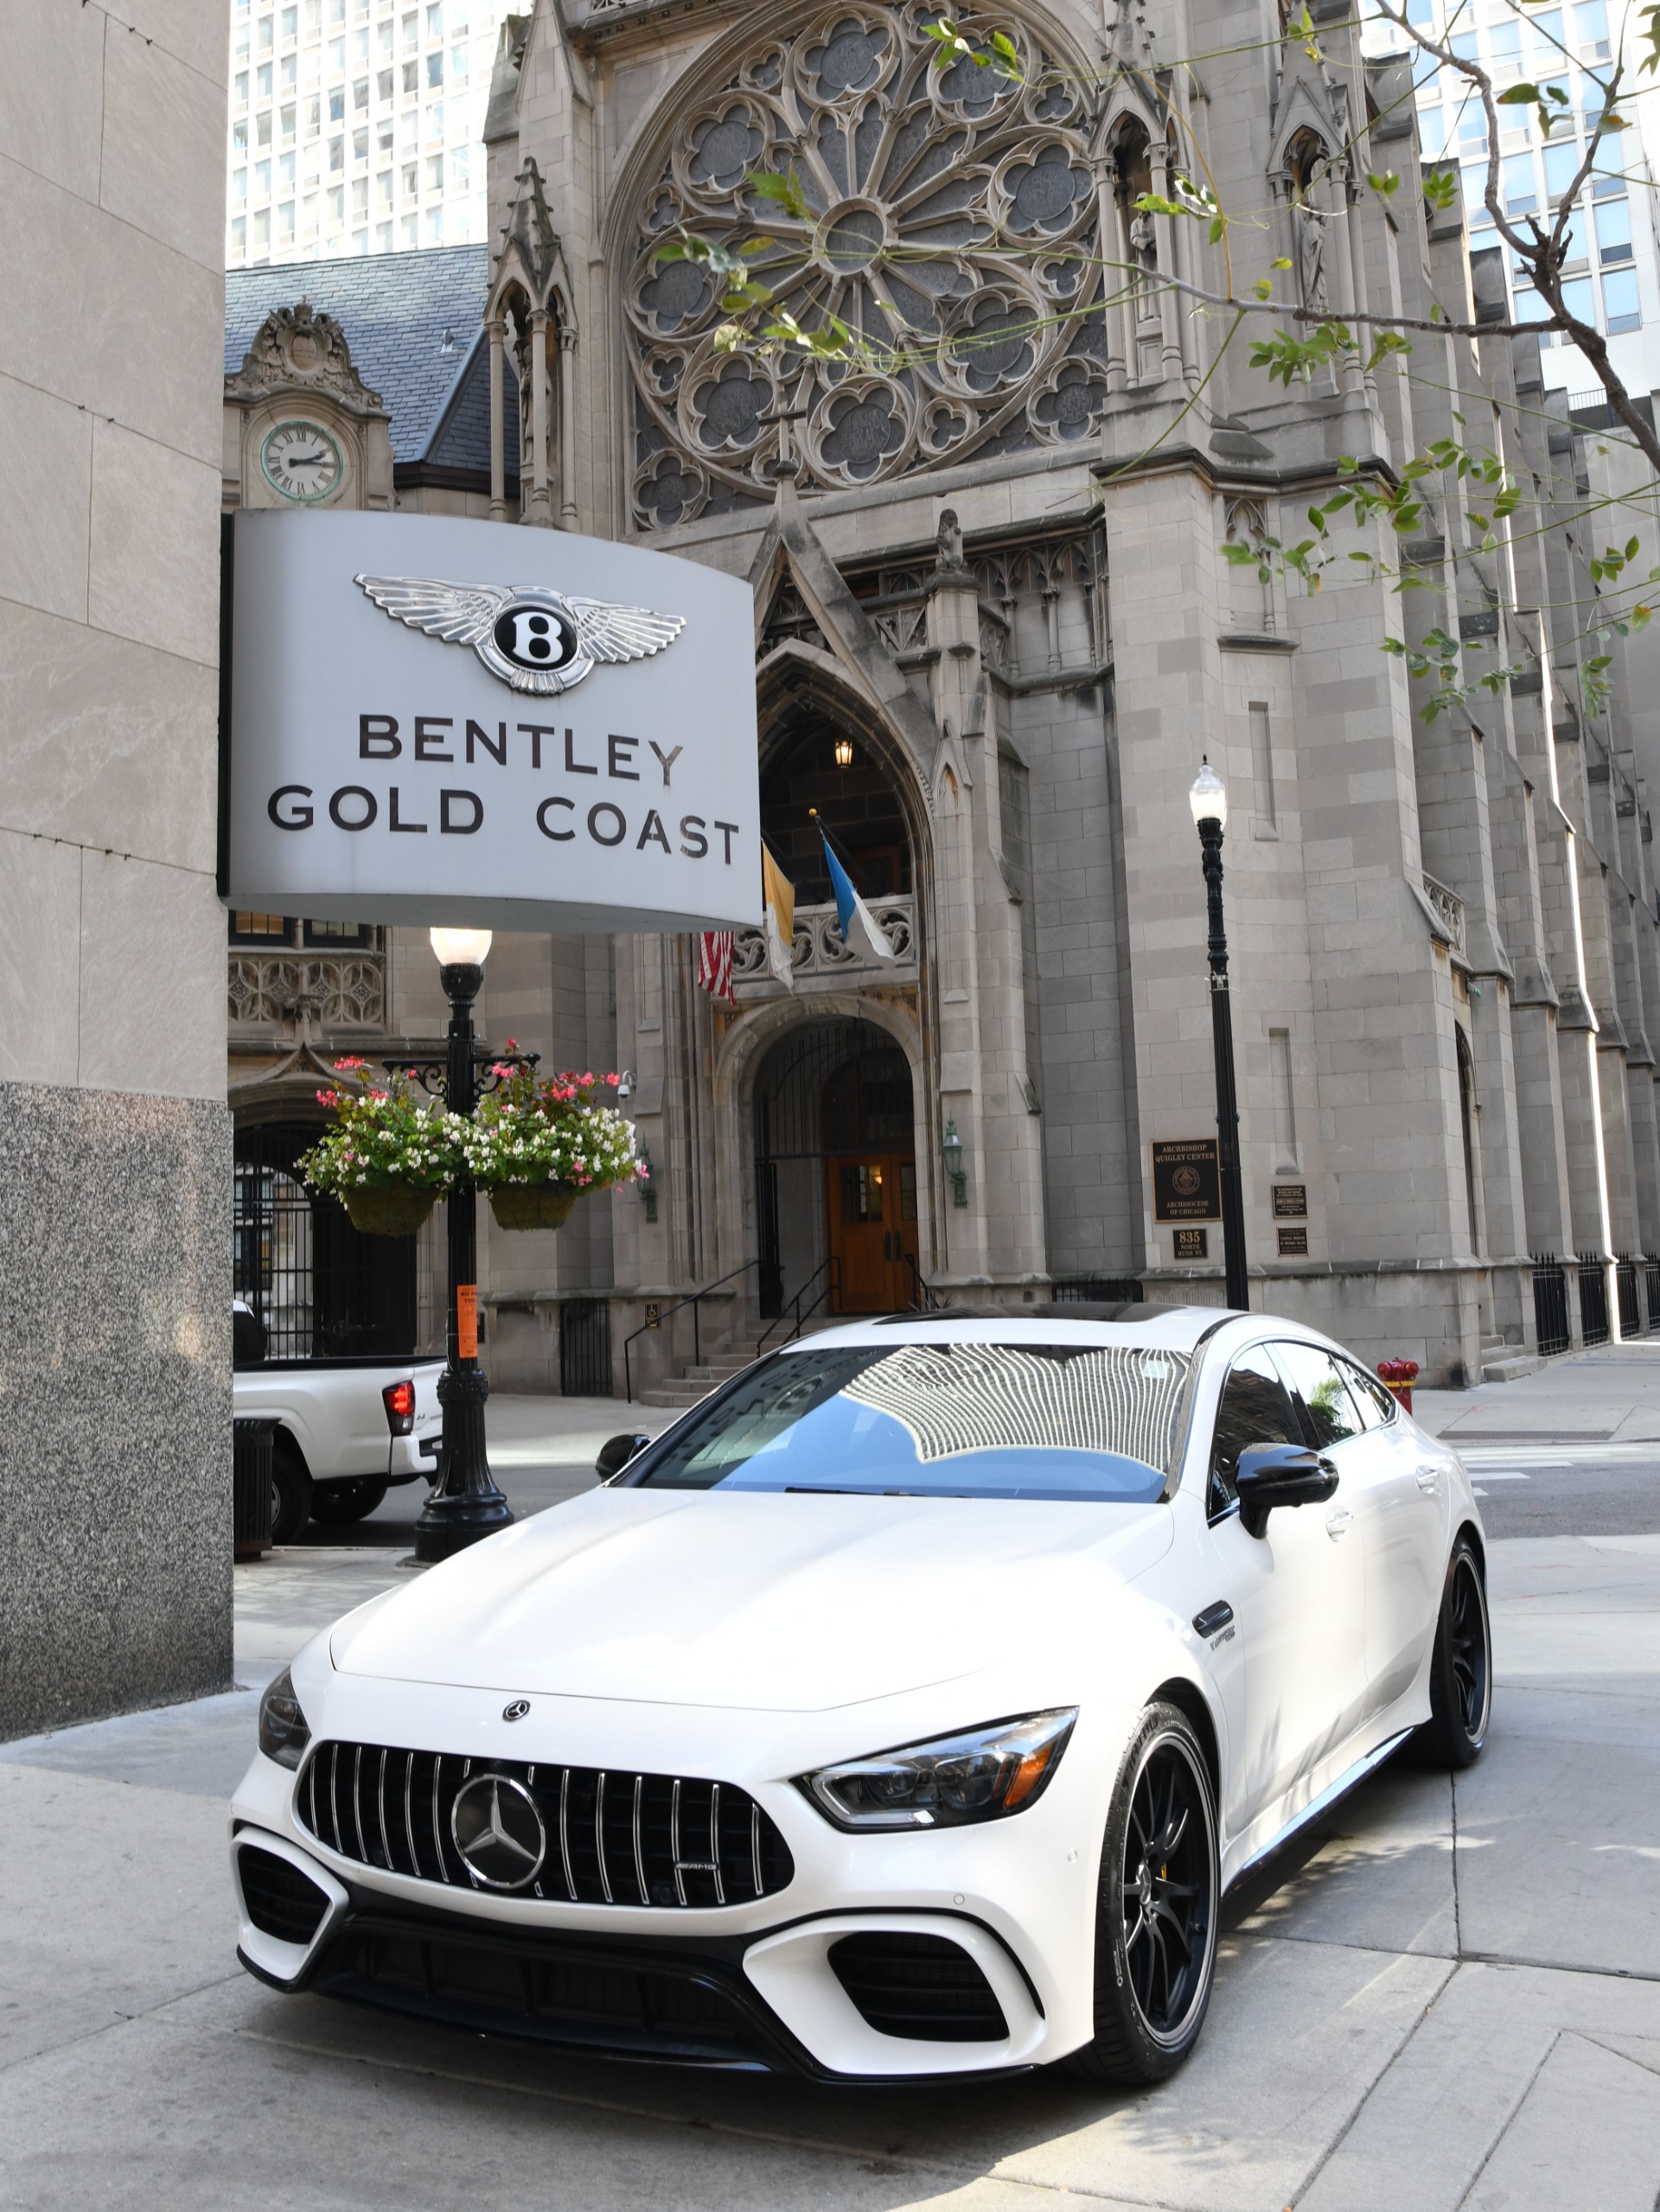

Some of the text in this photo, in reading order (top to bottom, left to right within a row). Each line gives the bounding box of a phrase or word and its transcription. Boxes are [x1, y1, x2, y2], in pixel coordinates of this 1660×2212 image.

[511, 611, 564, 664] B
[359, 713, 684, 787] BENTLEY
[266, 785, 740, 865] GOLD COAST
[1162, 1144, 1208, 1153] ARCHBISHOP
[1155, 1152, 1215, 1163] QUIGLEY CENTER
[1166, 1200, 1209, 1208] ARCHDIOCESE
[1179, 1230, 1200, 1244] 835
